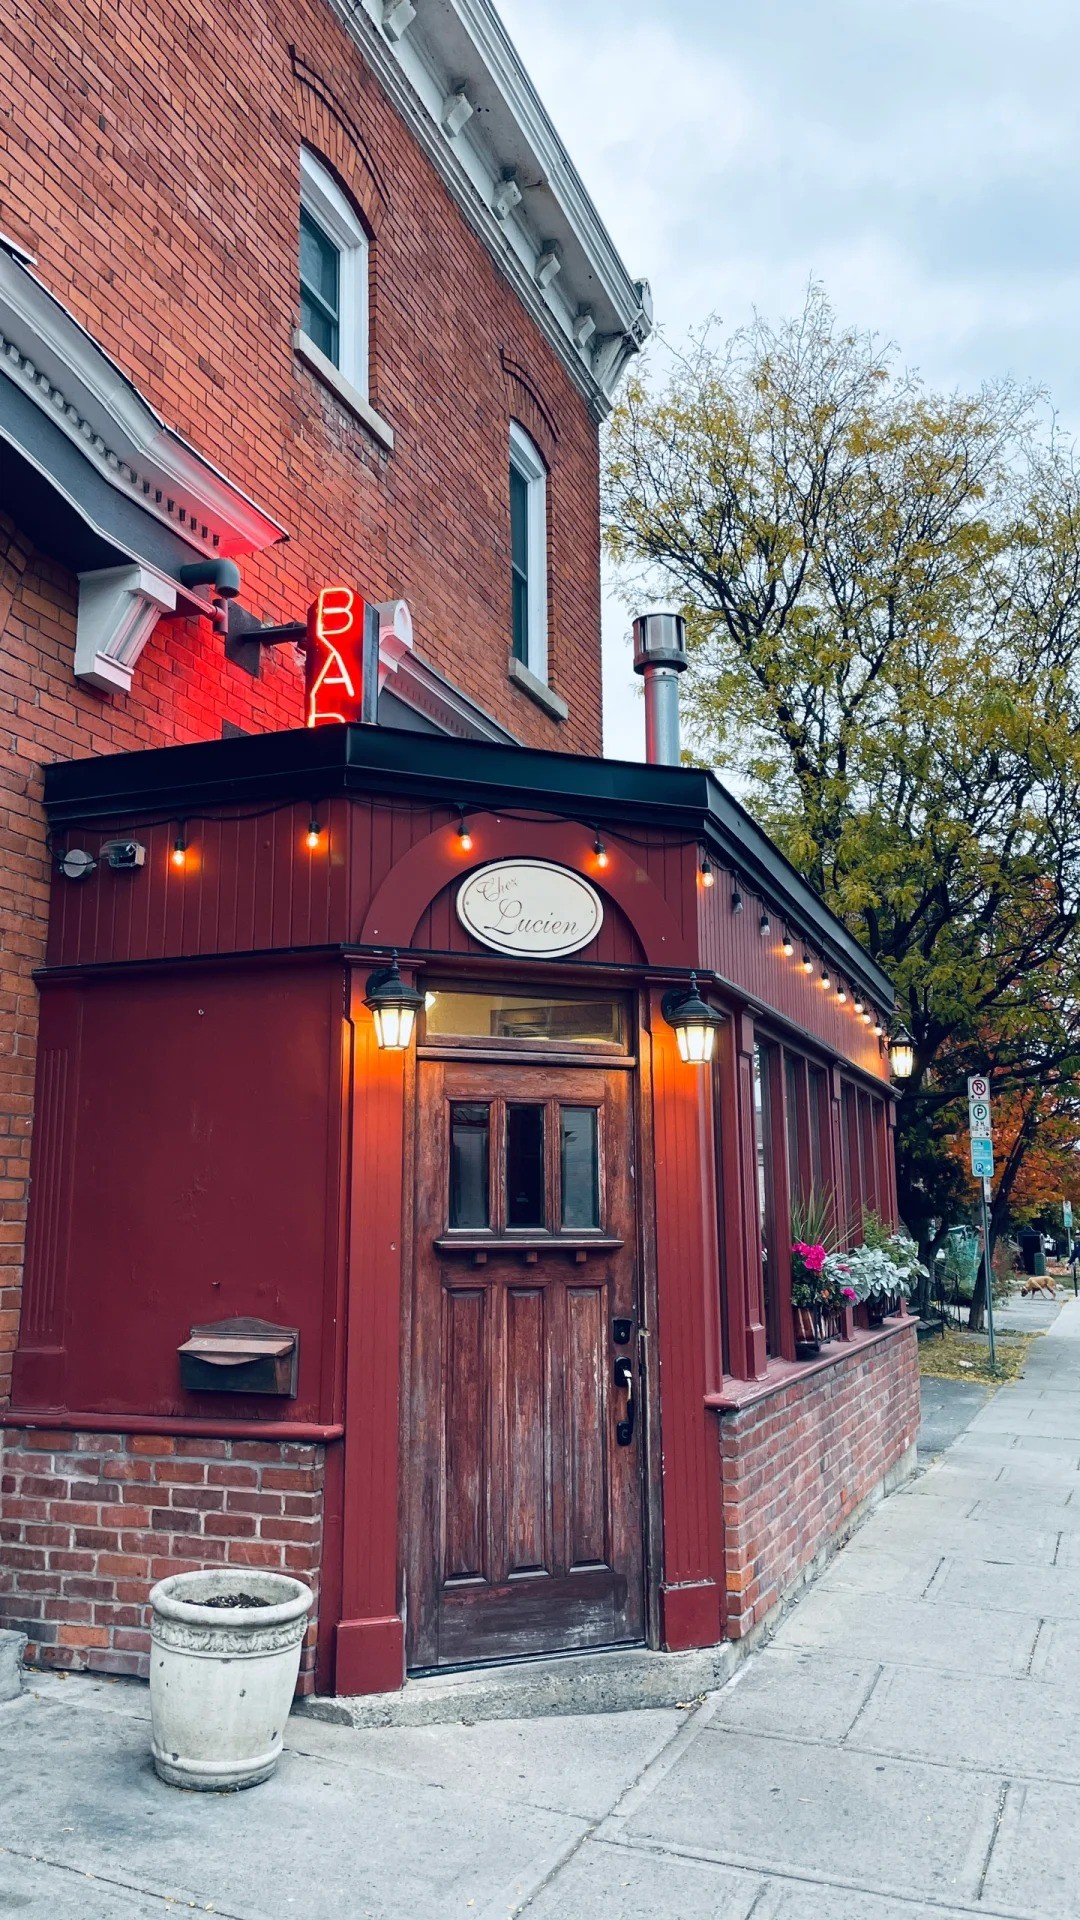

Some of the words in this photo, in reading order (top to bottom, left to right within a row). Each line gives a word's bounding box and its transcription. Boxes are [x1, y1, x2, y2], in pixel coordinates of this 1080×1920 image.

[307, 587, 355, 728] BA
[476, 876, 519, 902] Chez
[484, 898, 579, 935] Lucien
